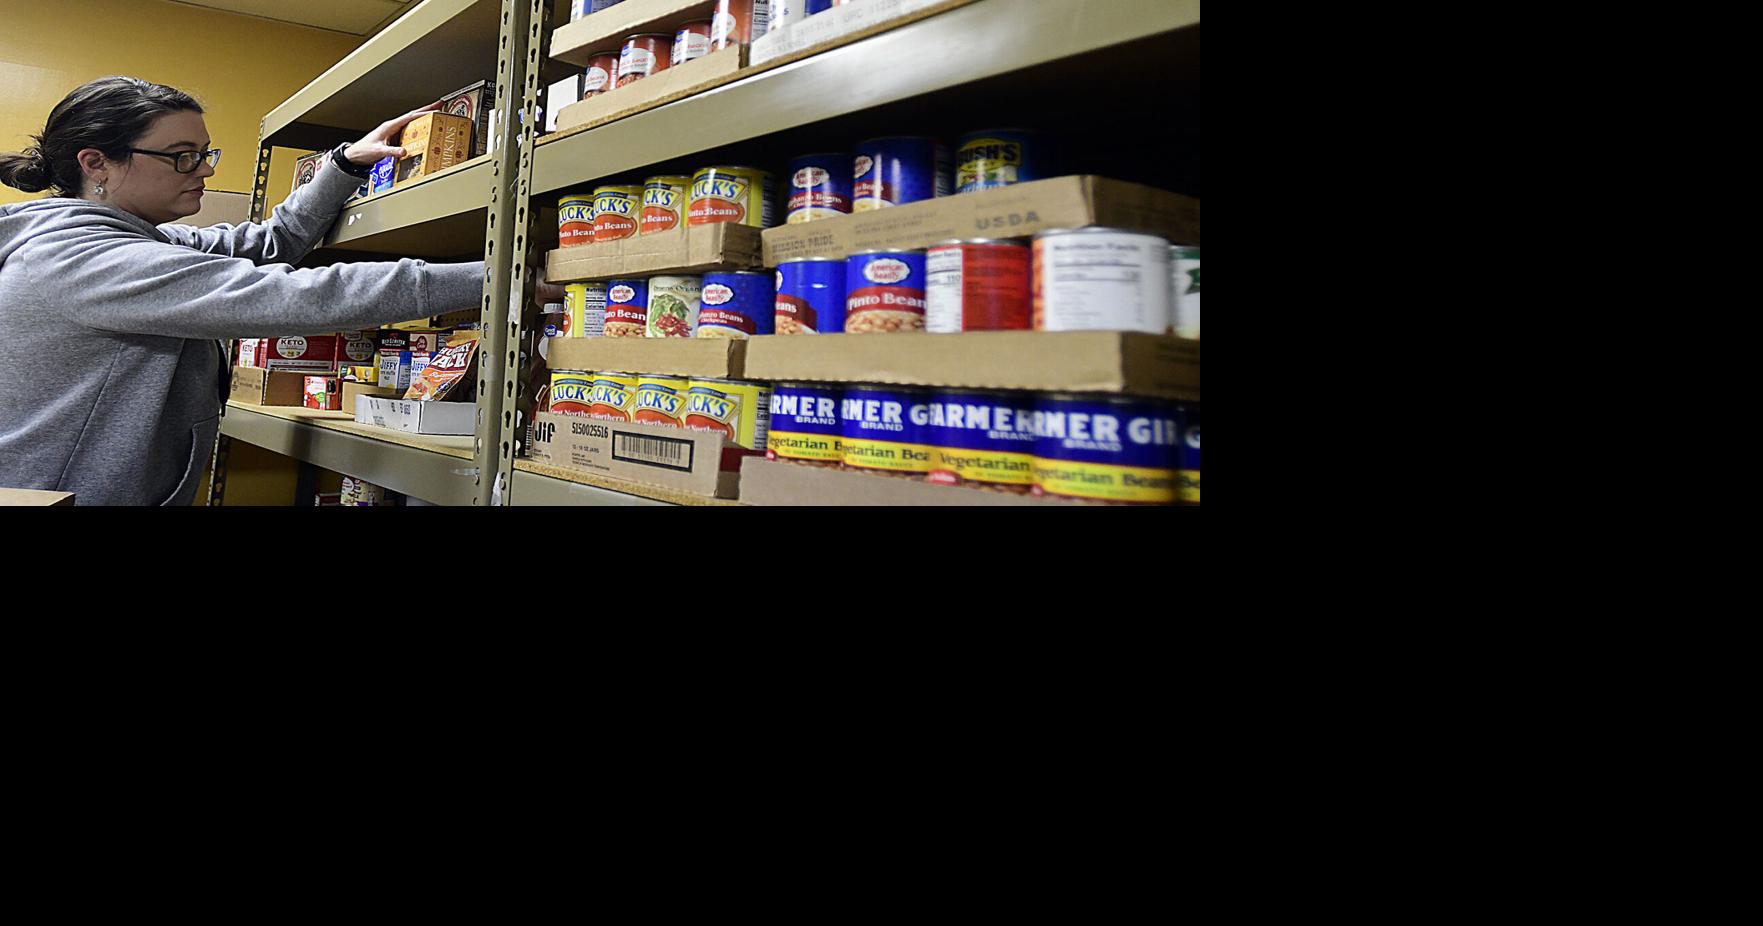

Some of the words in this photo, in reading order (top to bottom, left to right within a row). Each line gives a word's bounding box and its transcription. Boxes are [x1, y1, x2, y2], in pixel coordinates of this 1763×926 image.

[560, 206, 595, 223] UCK'S
[976, 211, 1040, 230] USDA
[604, 222, 632, 230] Beans
[719, 312, 744, 323] Beans
[381, 359, 398, 370] JIFFY
[770, 394, 836, 418] RMER
[794, 415, 837, 426] BRAND
[860, 420, 904, 431] BRAND
[535, 422, 556, 443] Jif
[940, 452, 1030, 471] Vegetarian
